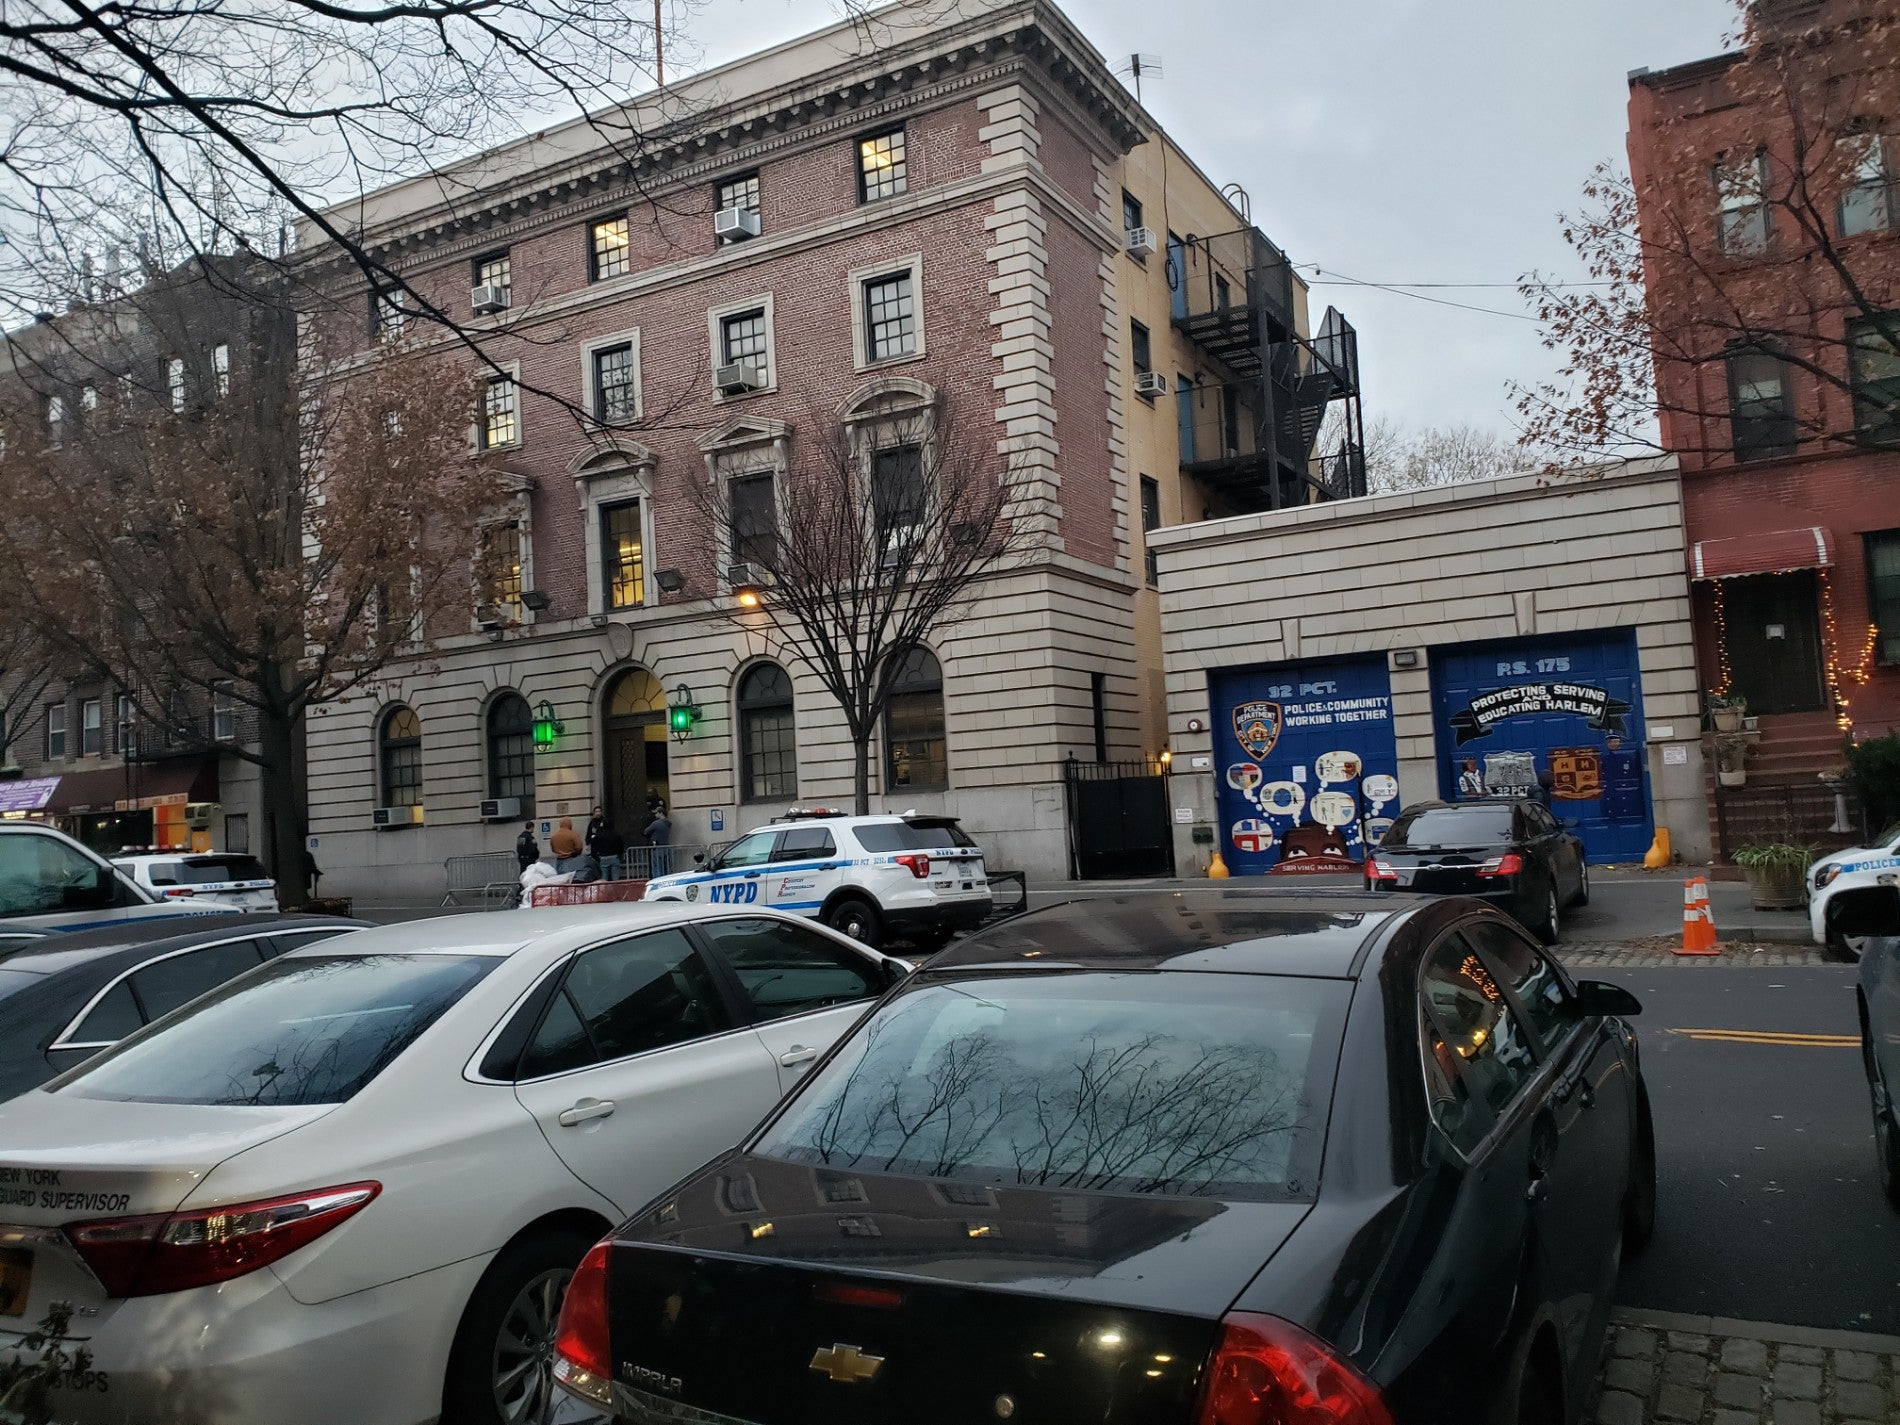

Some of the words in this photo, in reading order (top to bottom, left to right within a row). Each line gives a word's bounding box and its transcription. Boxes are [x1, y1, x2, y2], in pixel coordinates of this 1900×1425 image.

[1497, 660, 1531, 676] P.S.
[1535, 657, 1571, 673] 175
[1267, 684, 1293, 699] 32
[1299, 681, 1338, 696] PCT.
[1471, 685, 1547, 712] PROTECTING
[1553, 684, 1606, 702] SERVING
[1522, 695, 1552, 703] AND
[1236, 711, 1276, 724] DEPARTMENT
[1243, 704, 1268, 713] POLICE
[1477, 701, 1541, 724] EDUCATING
[1545, 700, 1602, 716] HARLEM
[1285, 715, 1332, 727] WORKING
[1334, 709, 1388, 723] TOGETHER
[1282, 864, 1315, 872] SERVING
[1854, 859, 1896, 871] POLICE
[710, 881, 758, 904] NYPD
[0, 1167, 21, 1183] EW
[25, 1168, 61, 1187] YORK
[41, 1190, 130, 1211] SUPERVISOR
